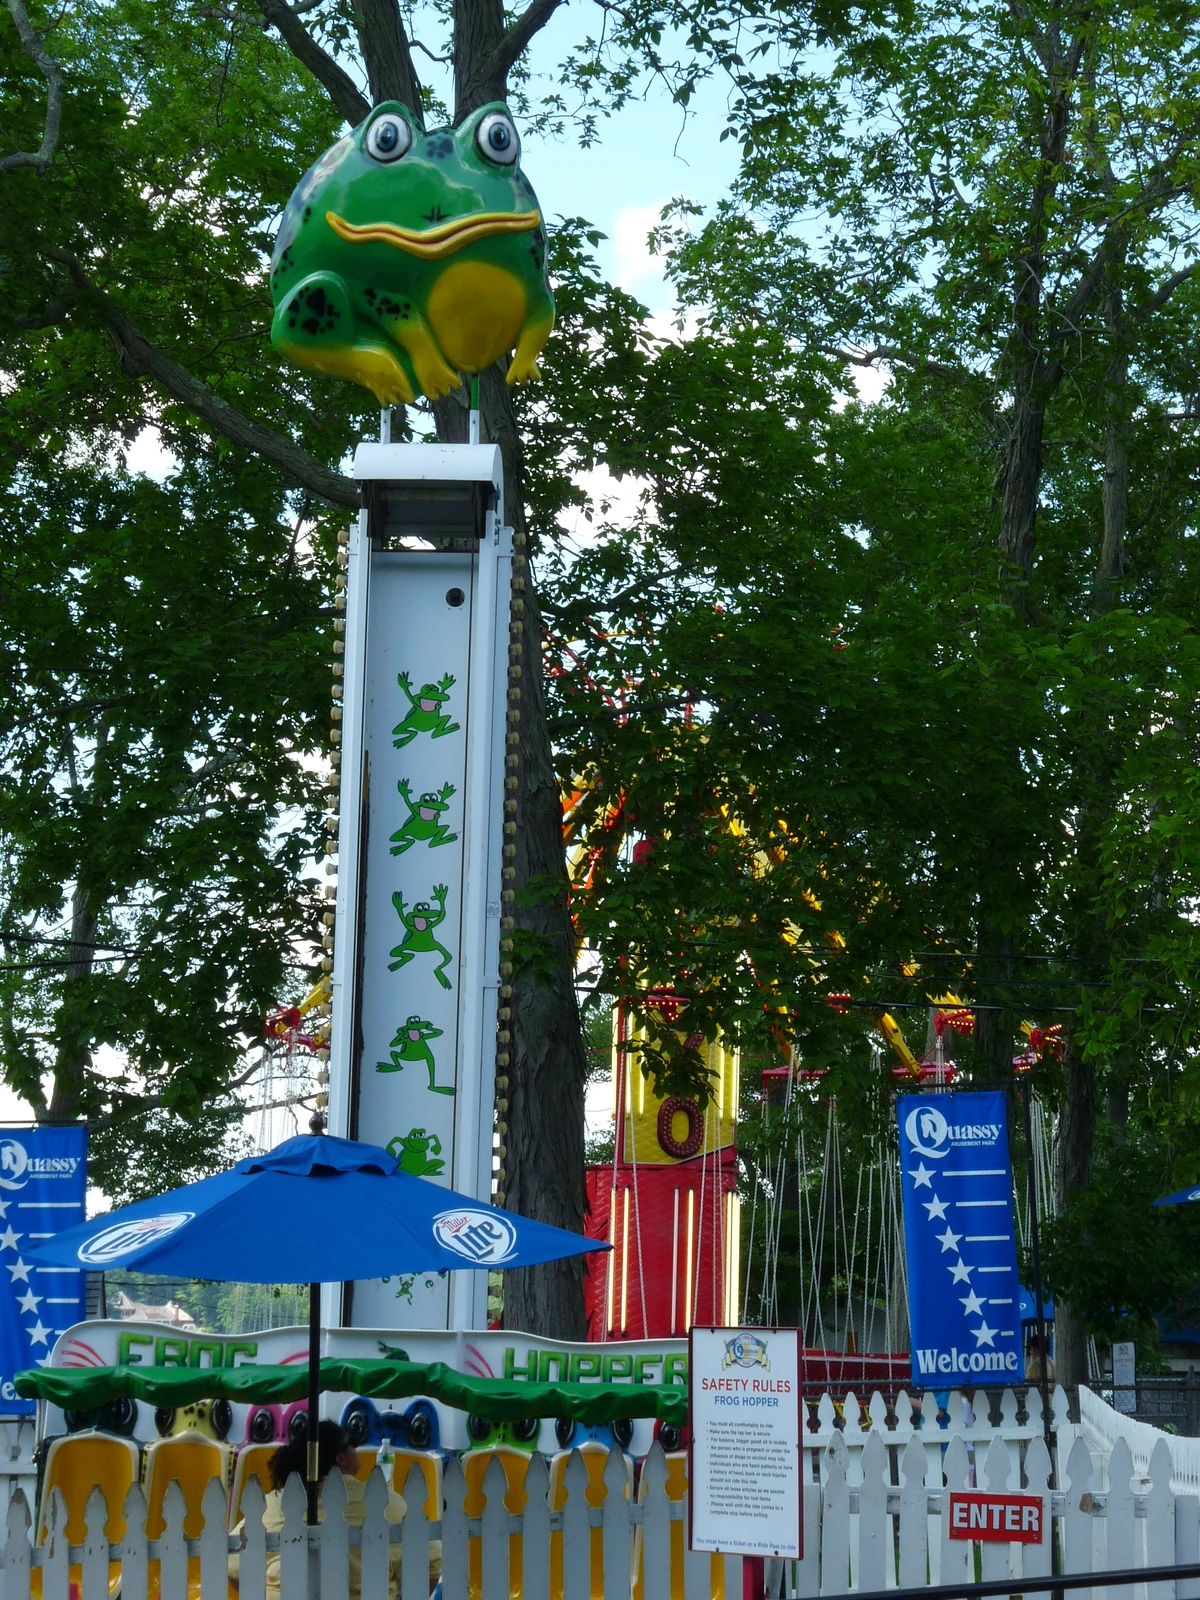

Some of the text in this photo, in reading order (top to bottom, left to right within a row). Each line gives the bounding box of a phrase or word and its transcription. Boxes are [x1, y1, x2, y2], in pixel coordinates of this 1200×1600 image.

[905, 1106, 1002, 1159] Quassy
[440, 1216, 470, 1233] Miller
[451, 1220, 503, 1261] Lite
[916, 1348, 1018, 1374] Welcome
[702, 1378, 791, 1393] SAFETY RULES
[715, 1396, 779, 1407] FROG HOPPER
[953, 1503, 1039, 1531] ENTER
